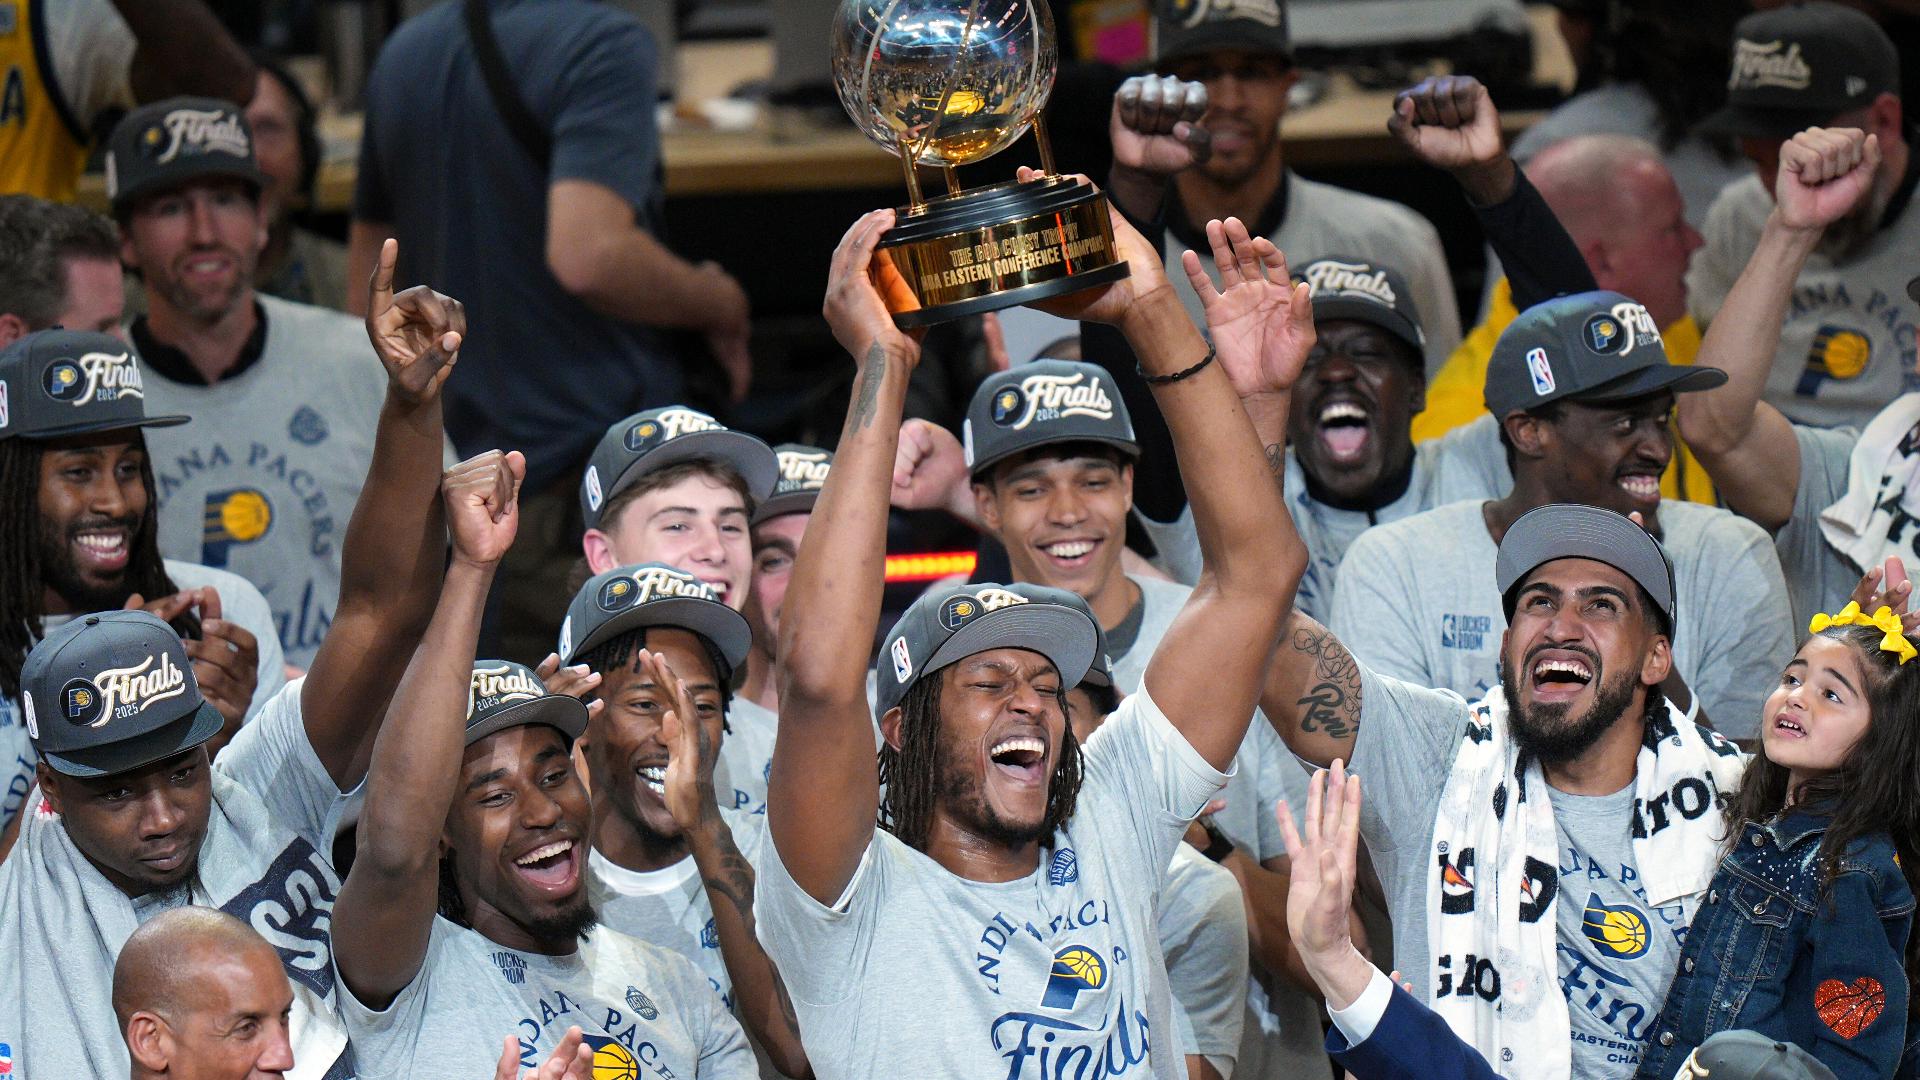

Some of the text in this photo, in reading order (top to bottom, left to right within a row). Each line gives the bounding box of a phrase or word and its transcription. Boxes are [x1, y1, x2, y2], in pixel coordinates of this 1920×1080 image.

[157, 108, 250, 166] Finals
[944, 262, 993, 287] EASTERN
[993, 246, 1061, 277] CONFERENCE
[949, 247, 974, 268] THE
[975, 240, 1000, 262] BOB
[1304, 260, 1397, 310] Finals
[1012, 372, 1114, 431] Finals
[1036, 408, 1060, 422] 2025
[91, 651, 186, 728] Finals
[466, 665, 545, 721] Finals
[476, 696, 500, 712] 2025
[115, 702, 139, 720] 2025
[1570, 1030, 1640, 1054] EASTERN
